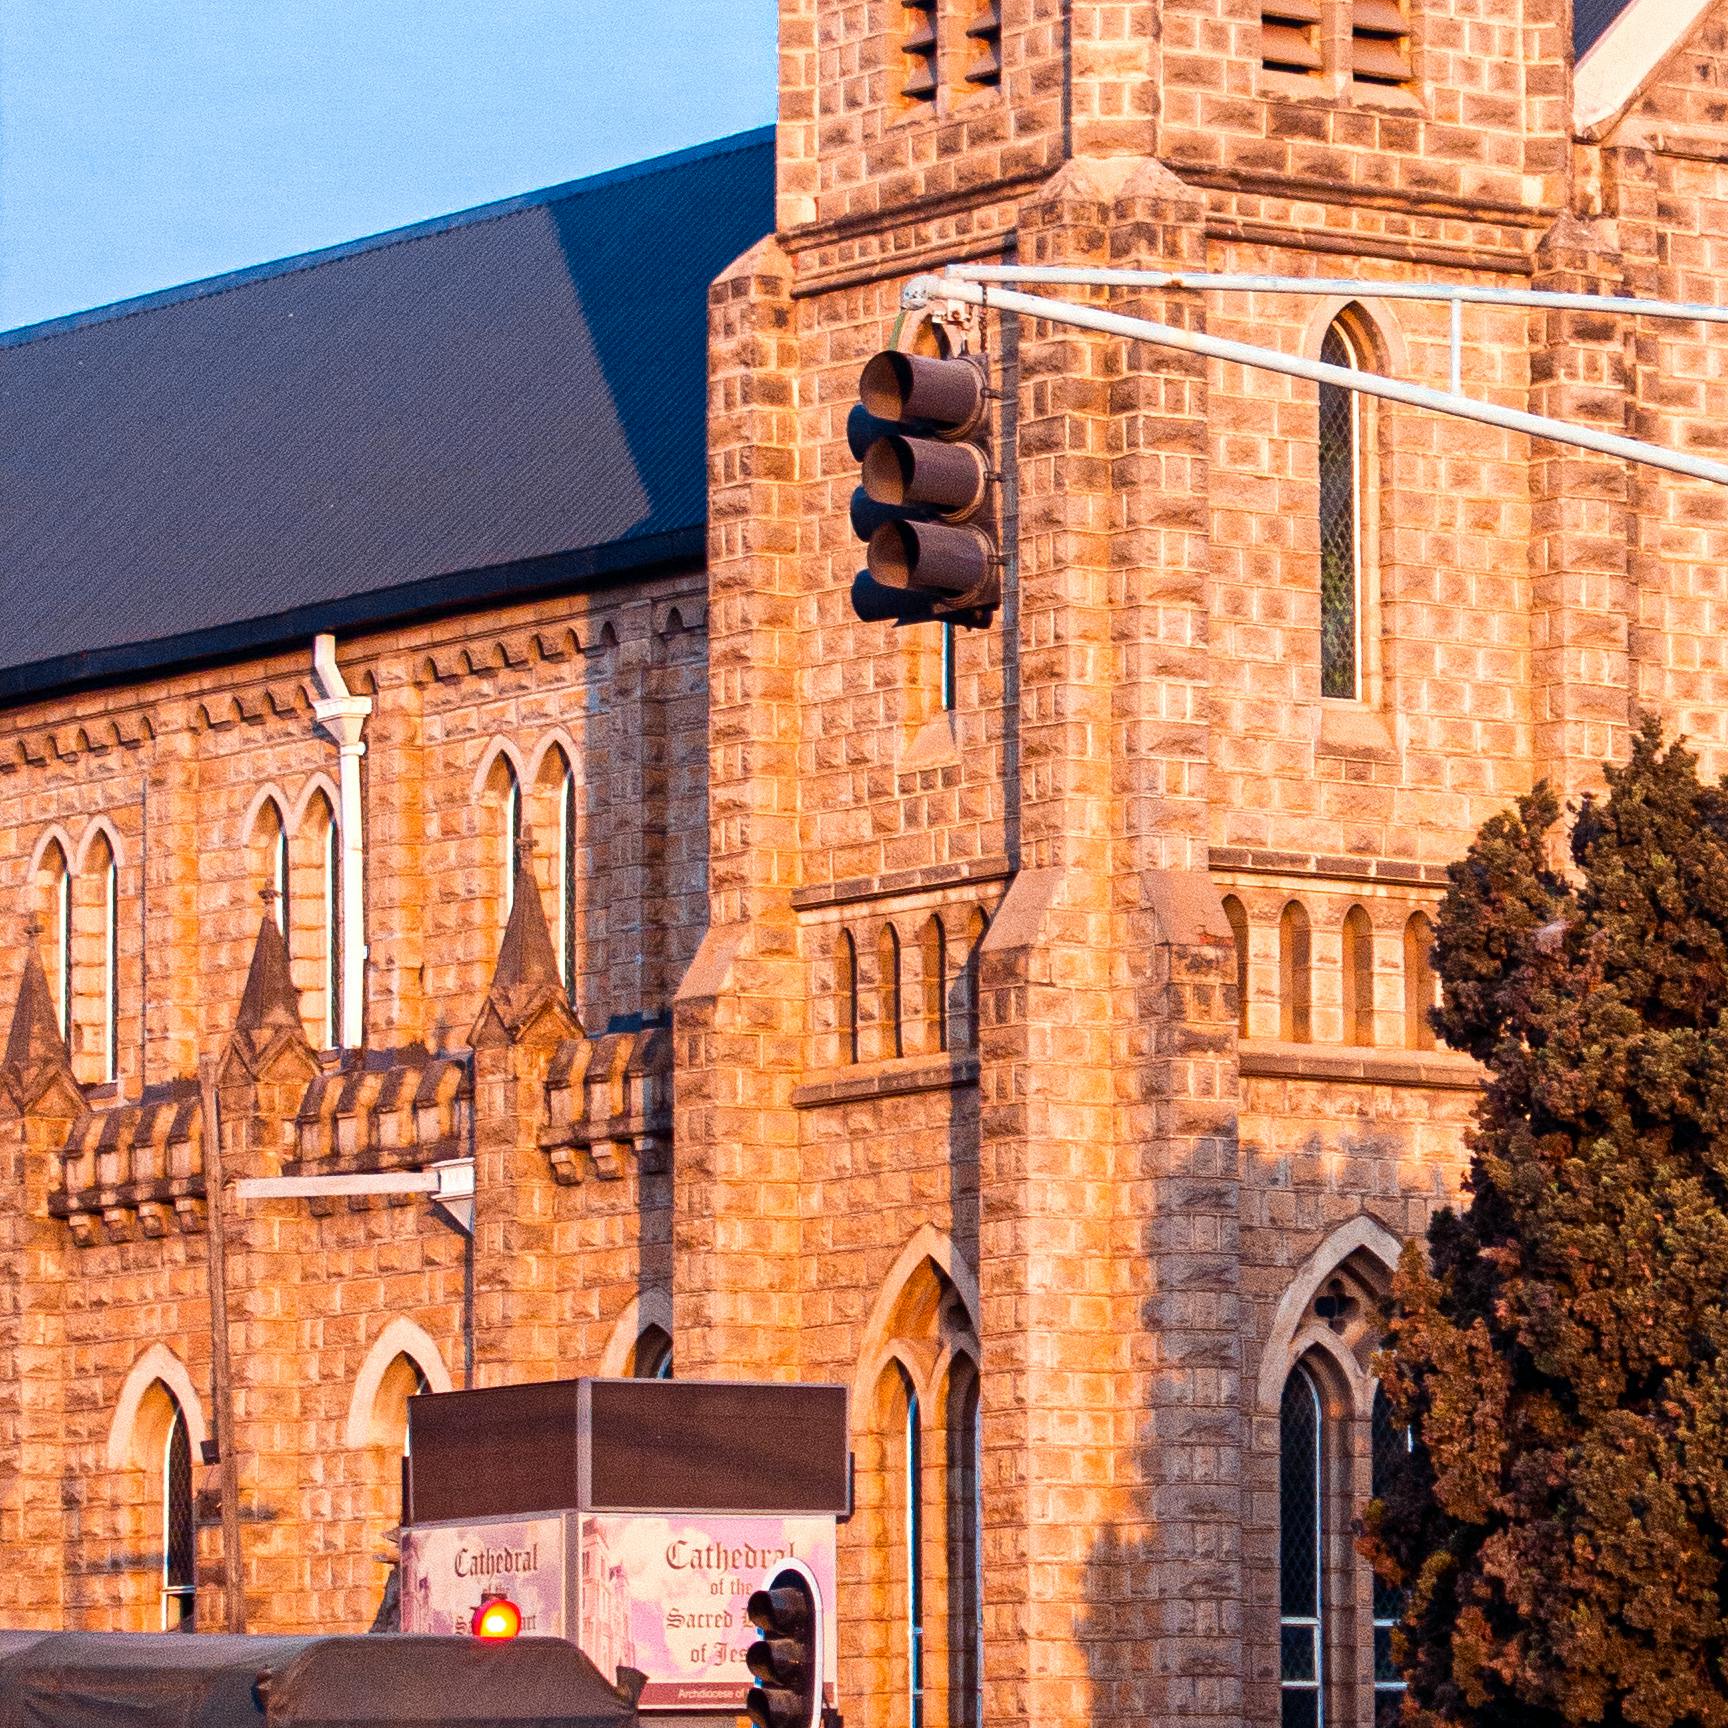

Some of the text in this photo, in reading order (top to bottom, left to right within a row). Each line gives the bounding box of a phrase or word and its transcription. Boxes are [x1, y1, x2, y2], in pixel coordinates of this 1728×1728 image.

[454, 1543, 539, 1578] Cathedral
[665, 1540, 796, 1572] Cathedral
[709, 1579, 753, 1596] of the
[666, 1608, 733, 1629] Sacred
[690, 1642, 748, 1666] of Jes
